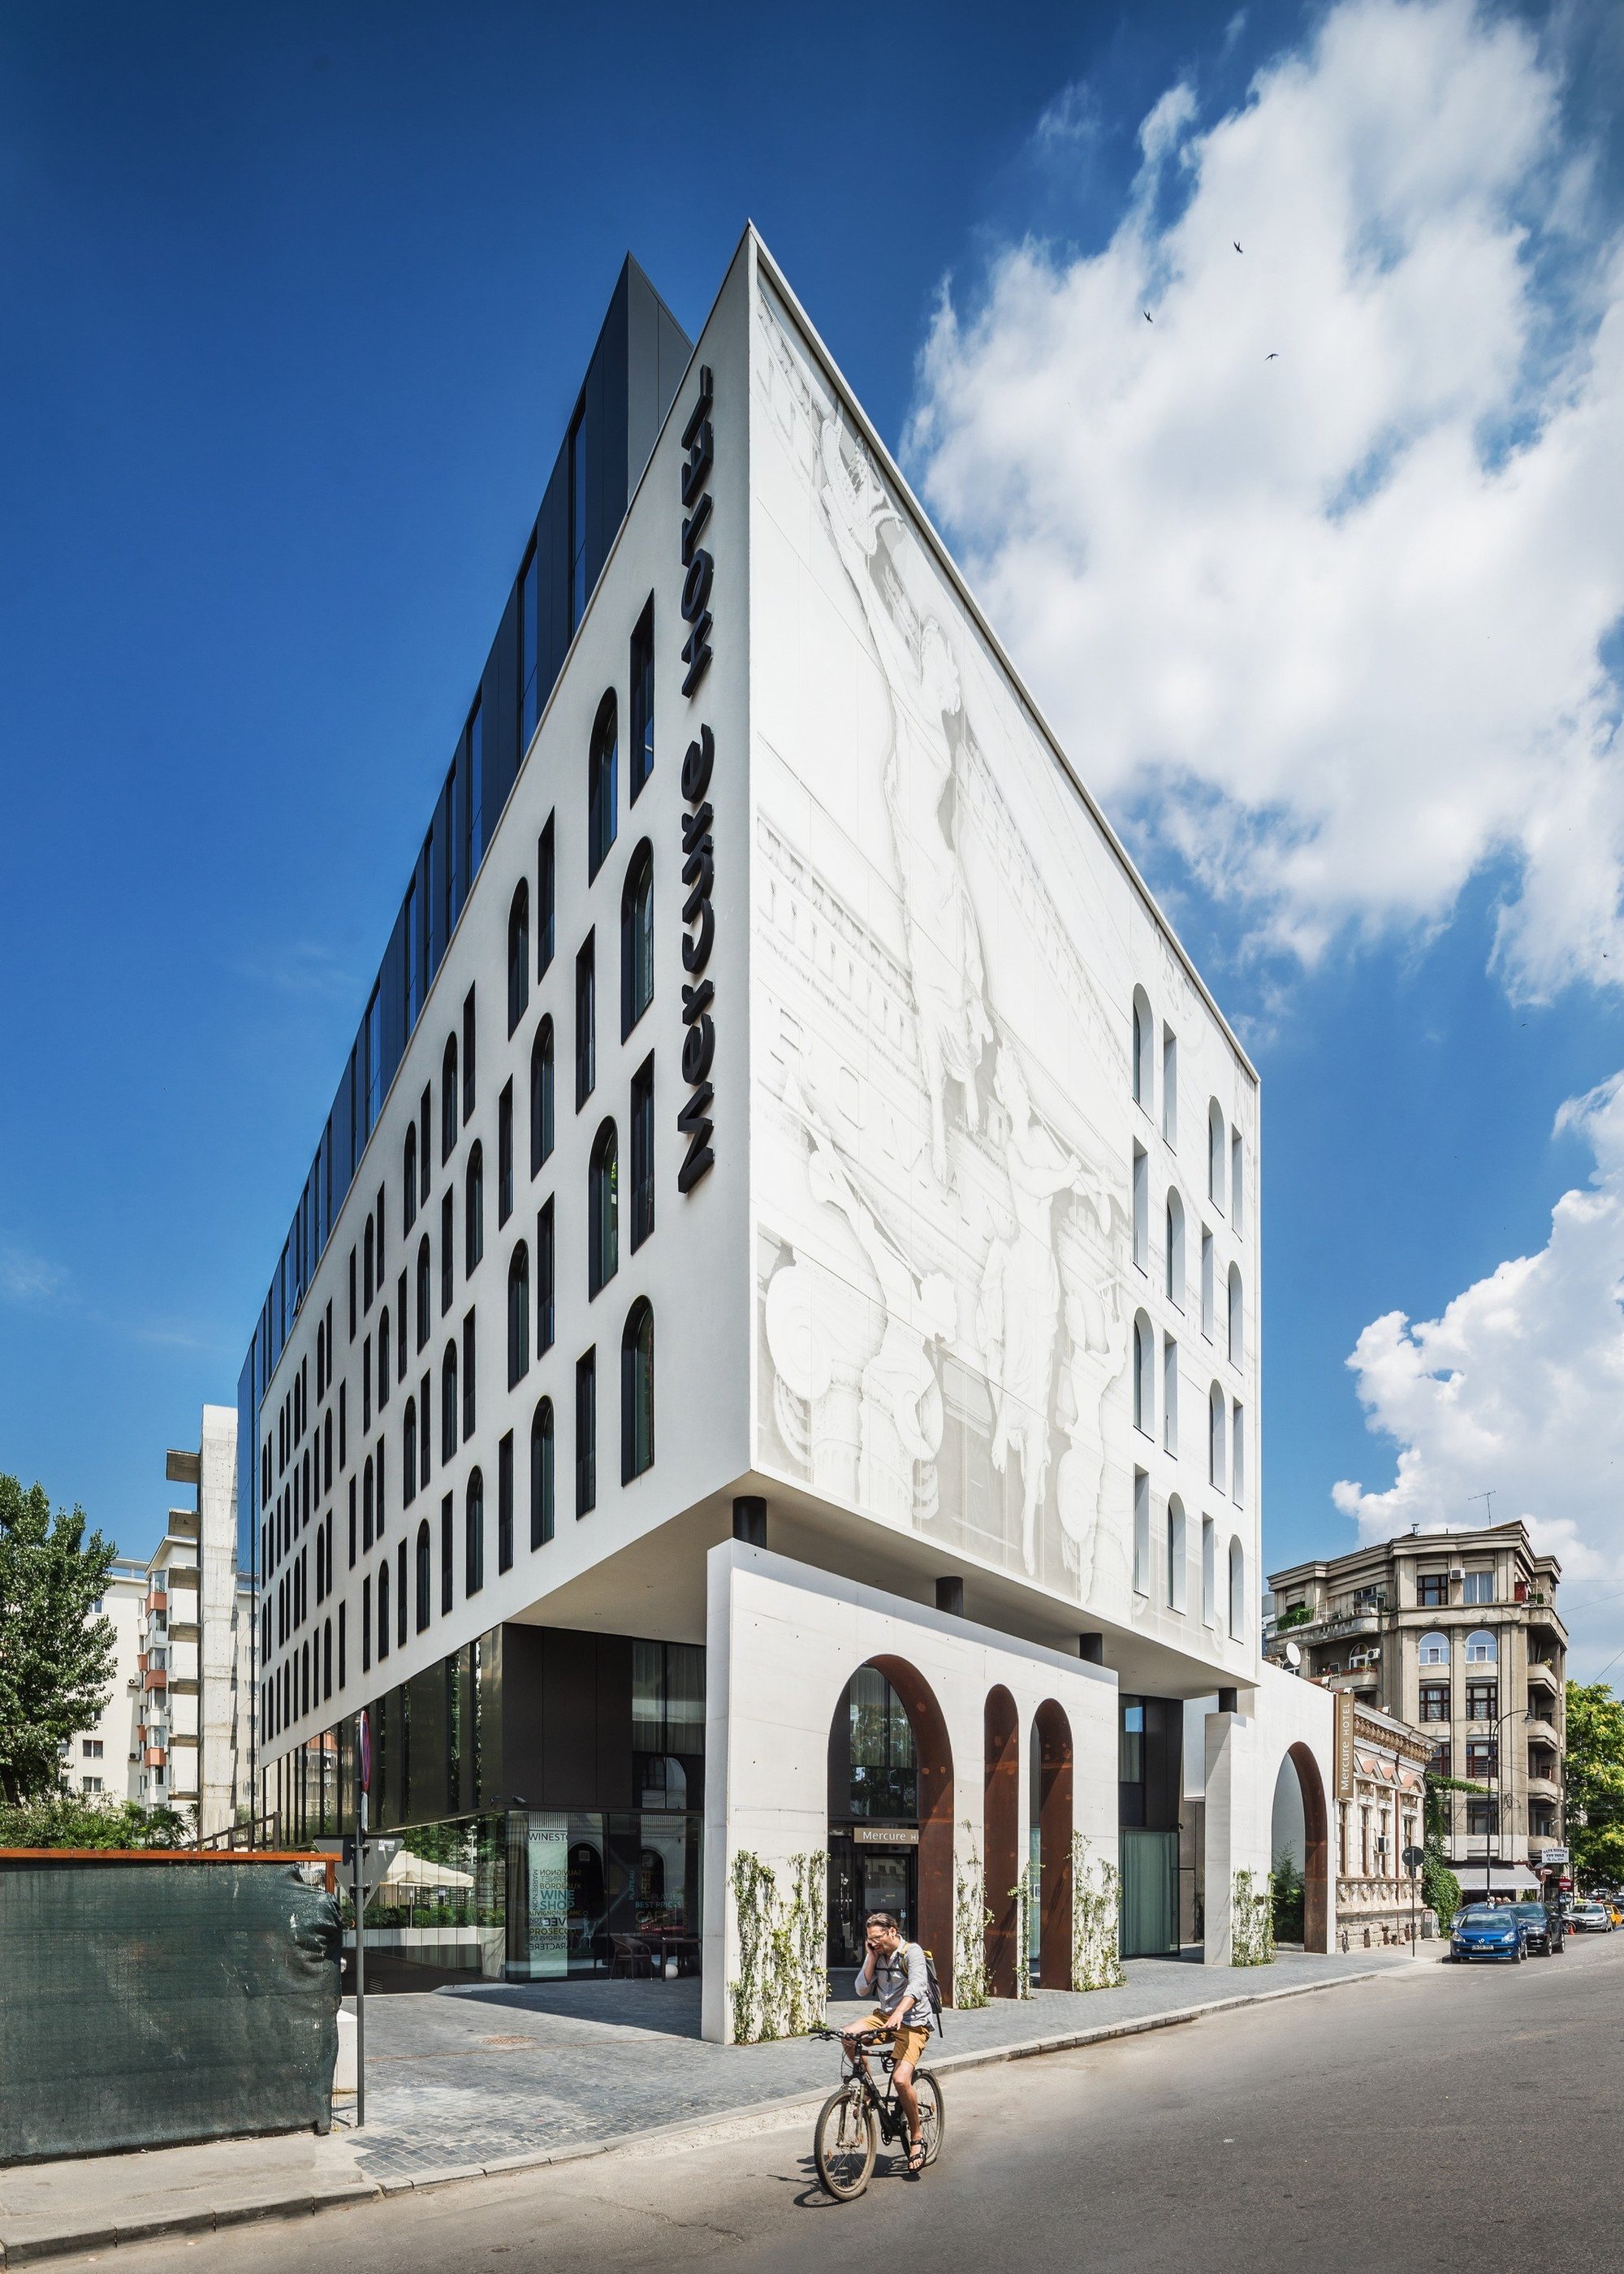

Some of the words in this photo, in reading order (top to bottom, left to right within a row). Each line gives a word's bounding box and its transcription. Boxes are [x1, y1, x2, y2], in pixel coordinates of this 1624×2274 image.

[680, 363, 715, 700] HOTEL
[677, 723, 715, 1195] Mercure
[1342, 1702, 1350, 1736] HOTEL
[1341, 1741, 1350, 1790] Mercure
[862, 1831, 906, 1841] Mercure
[539, 1900, 576, 1911] SHOP
[540, 1890, 576, 1900] WINE
